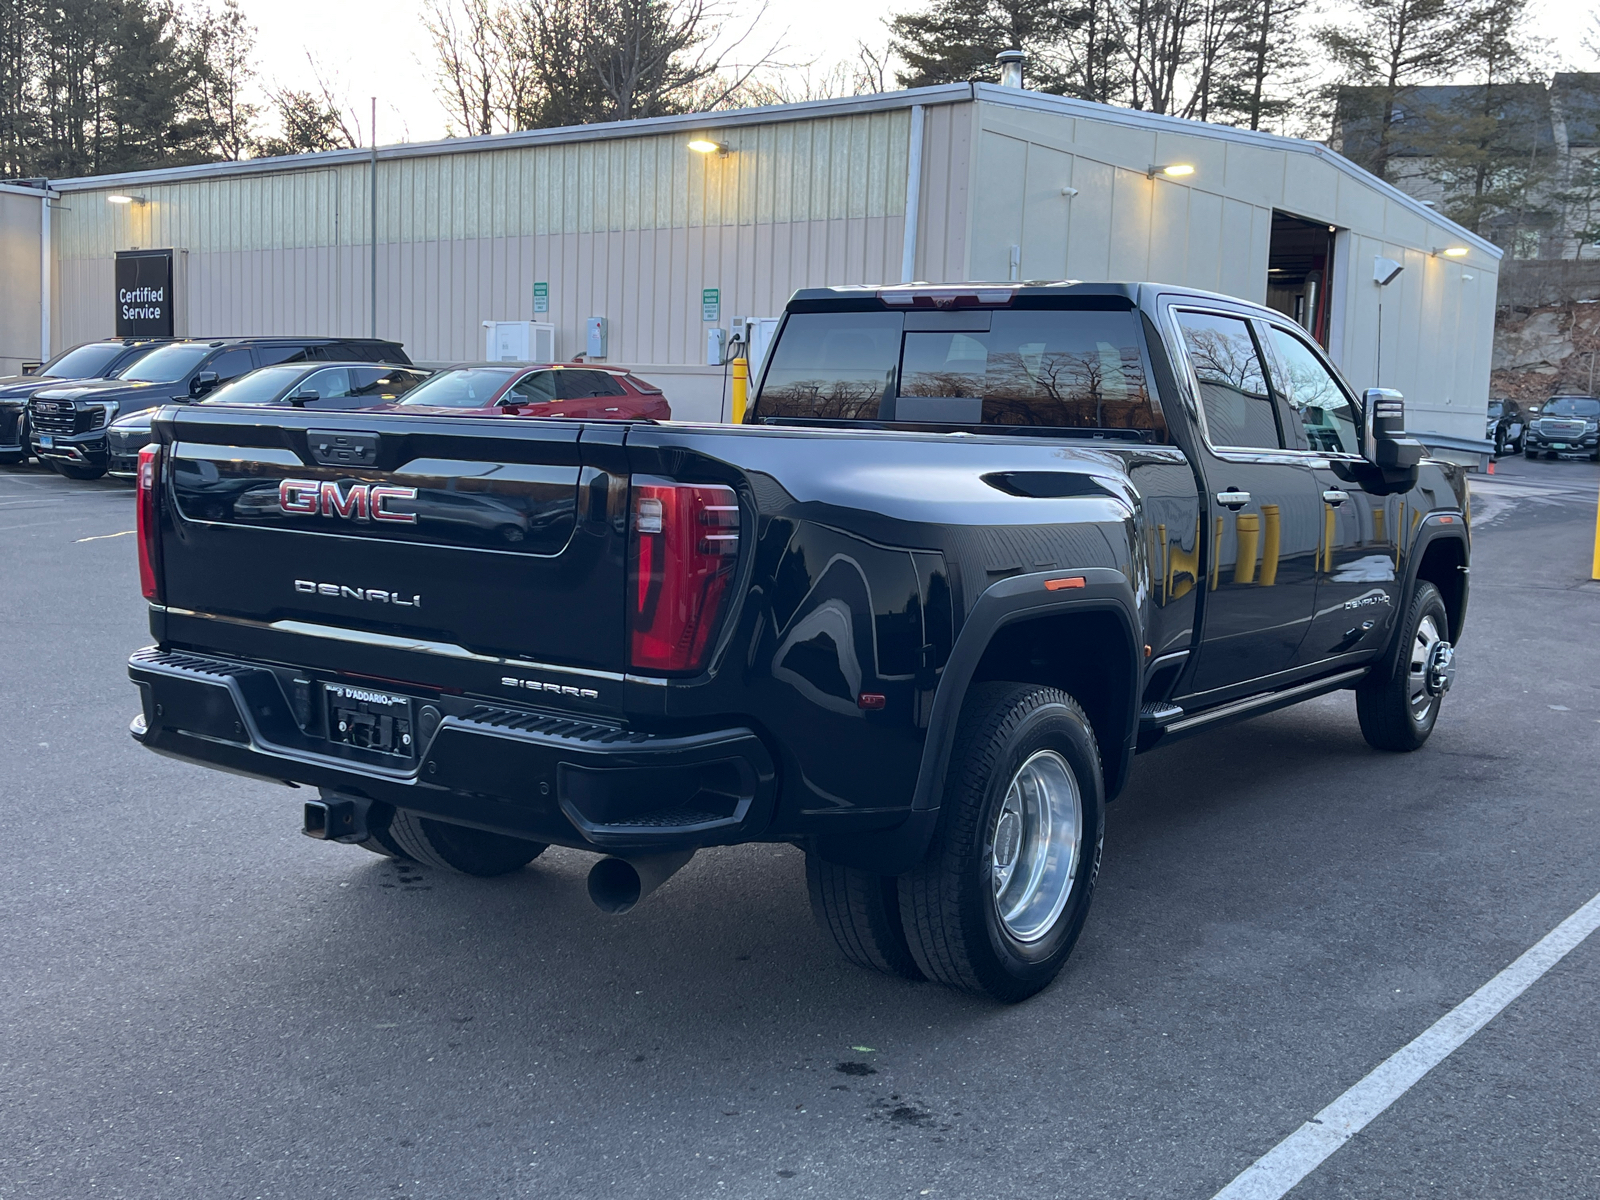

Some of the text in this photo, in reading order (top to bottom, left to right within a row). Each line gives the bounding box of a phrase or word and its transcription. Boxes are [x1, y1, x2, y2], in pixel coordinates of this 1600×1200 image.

[120, 286, 163, 303] Certified
[122, 303, 161, 319] Service
[278, 478, 418, 525] GMC
[294, 579, 421, 608] DENALI
[345, 688, 388, 705] D'ADDARIO
[501, 676, 599, 699] SIERRA
